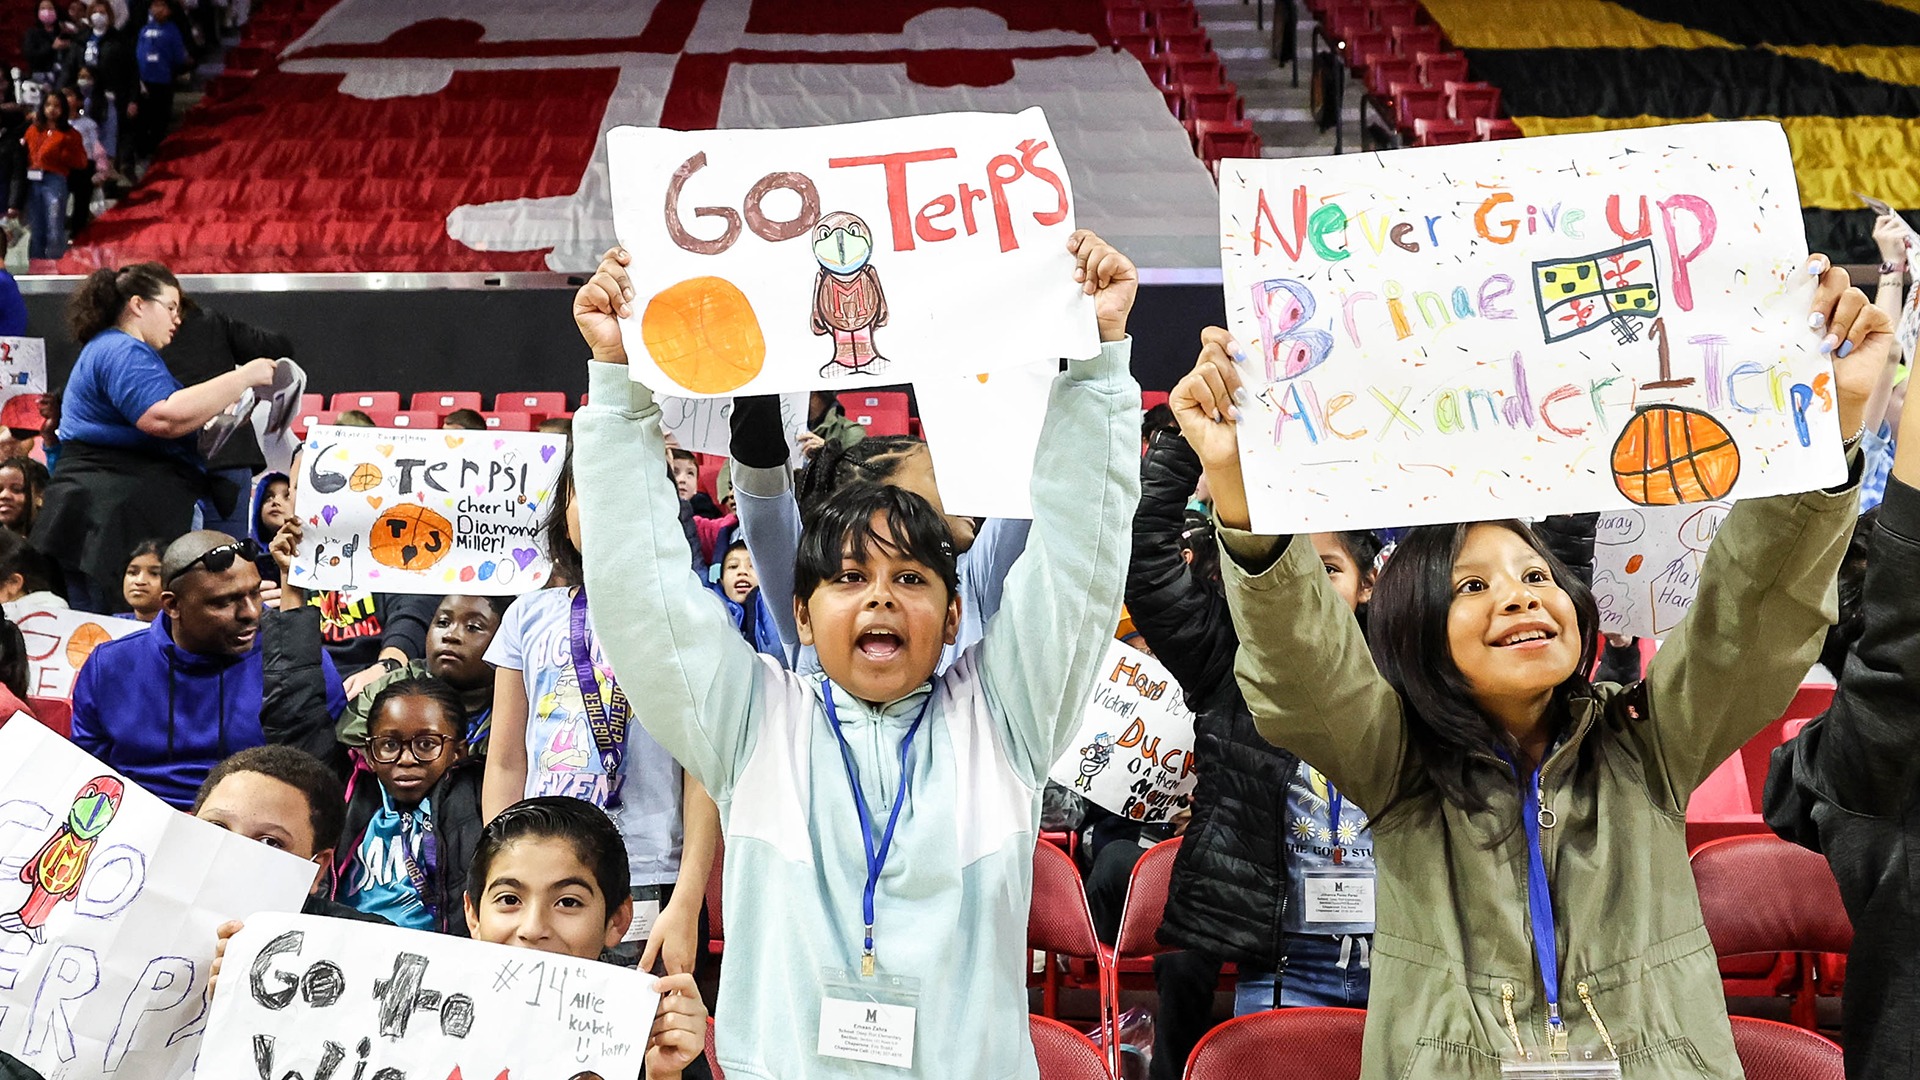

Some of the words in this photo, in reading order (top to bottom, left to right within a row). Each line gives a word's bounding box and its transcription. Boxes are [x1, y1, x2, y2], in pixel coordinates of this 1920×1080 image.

[1254, 184, 1441, 263] Never
[1473, 191, 1586, 245] Give
[1687, 333, 1834, 448] Terps
[505, 499, 515, 518] 4
[456, 514, 540, 538] Diamond
[1595, 517, 1633, 536] ooray
[456, 535, 505, 555] Miller!
[584, 691, 613, 752] TOGETHER
[569, 992, 605, 1014] Allie
[865, 1008, 877, 1023] M
